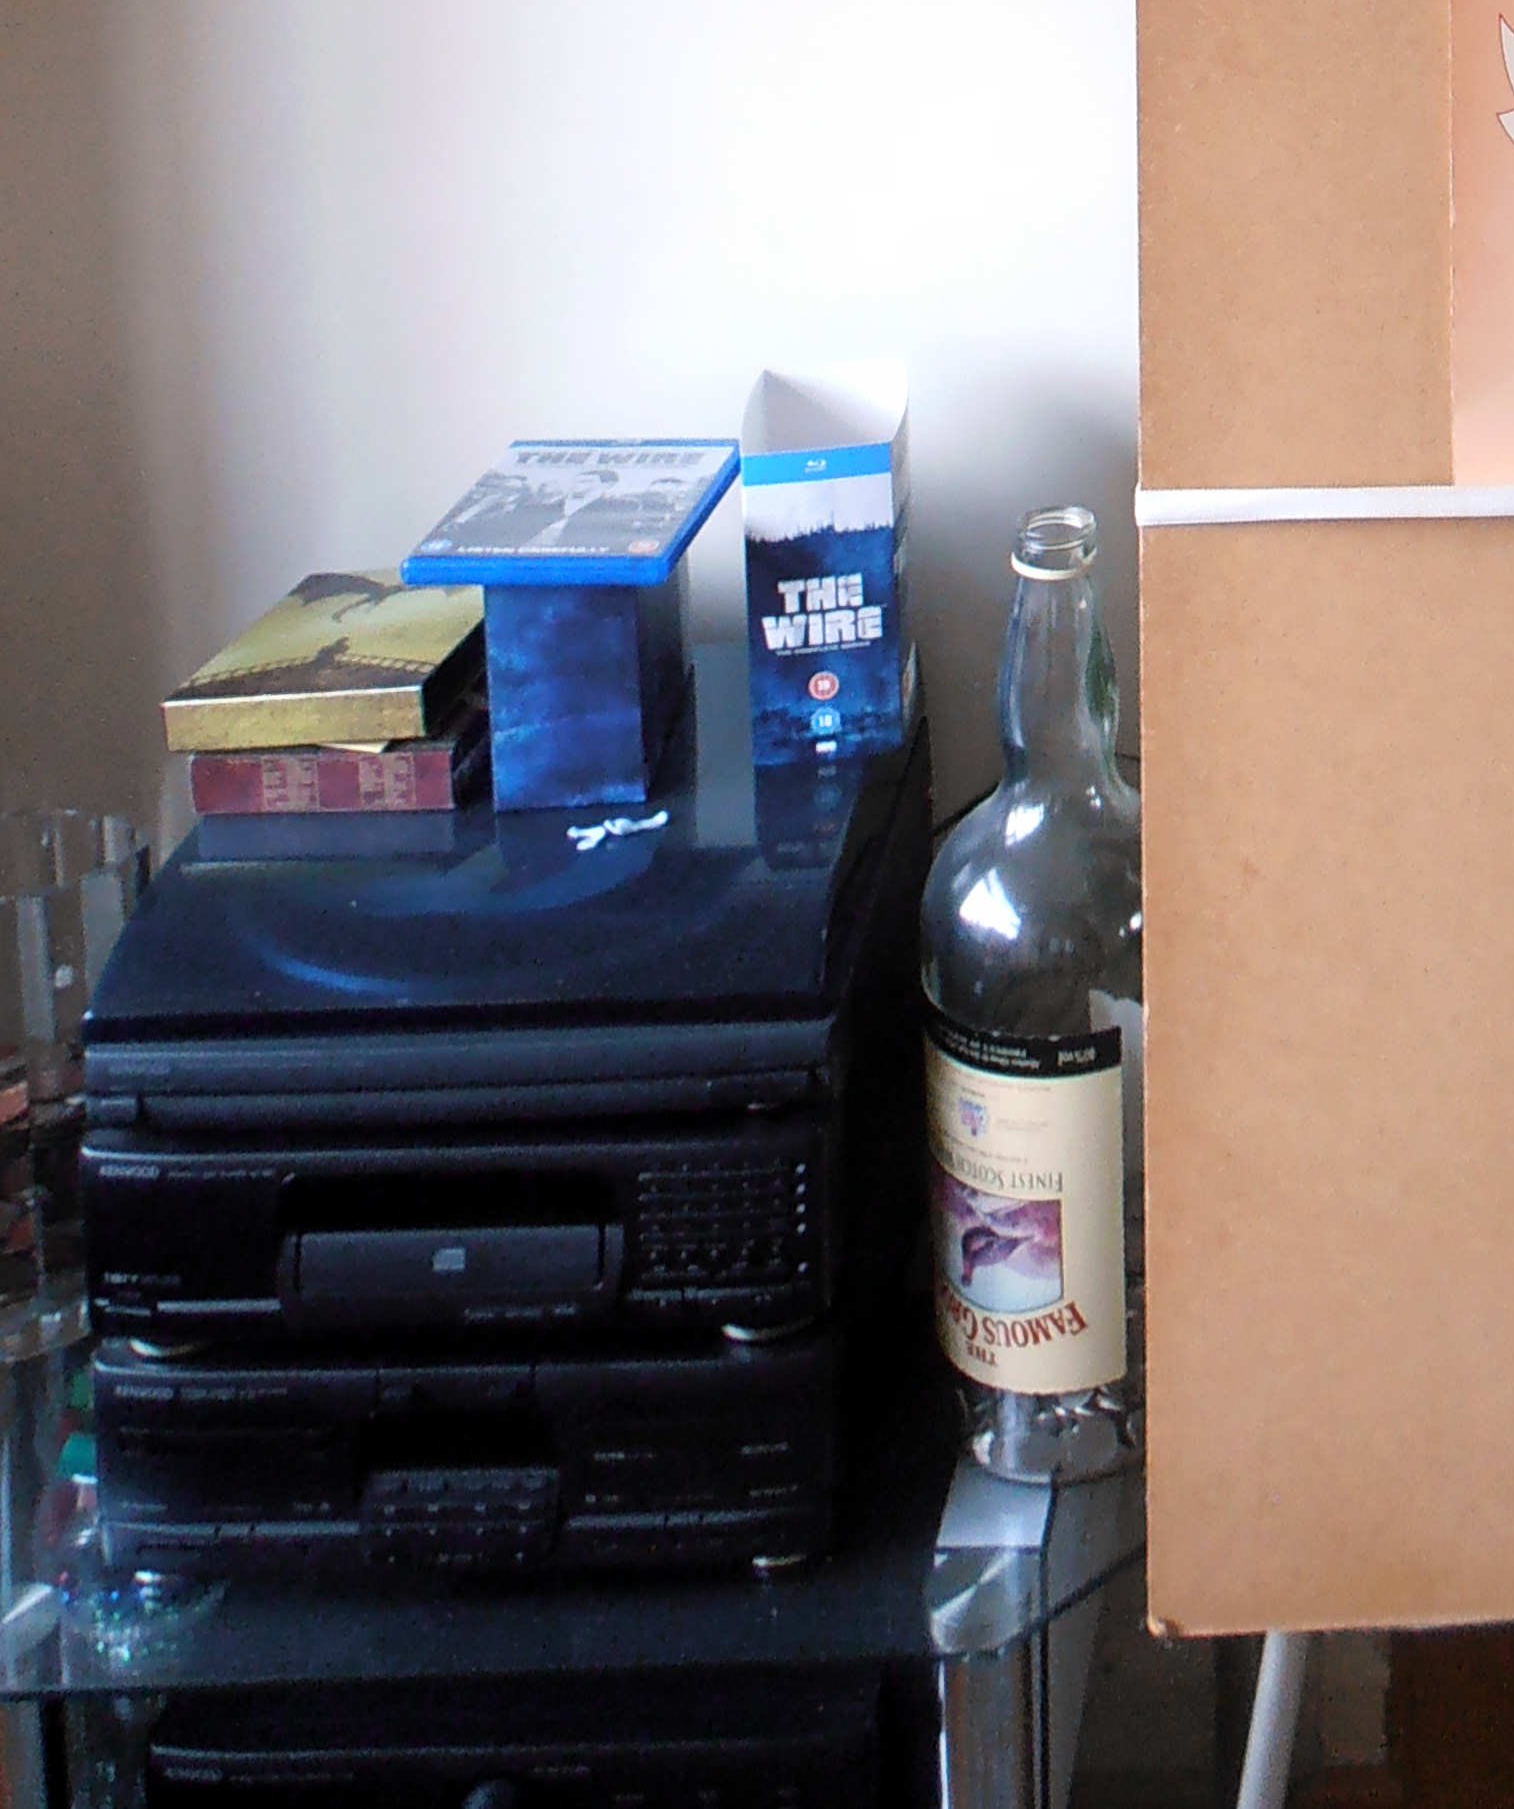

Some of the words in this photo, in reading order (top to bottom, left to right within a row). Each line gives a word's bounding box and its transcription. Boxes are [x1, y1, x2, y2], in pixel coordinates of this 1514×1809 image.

[777, 572, 864, 614] THE
[761, 605, 883, 651] WIRE
[1010, 1170, 1064, 1193] FINEST
[981, 1300, 1089, 1348] FAMOUS
